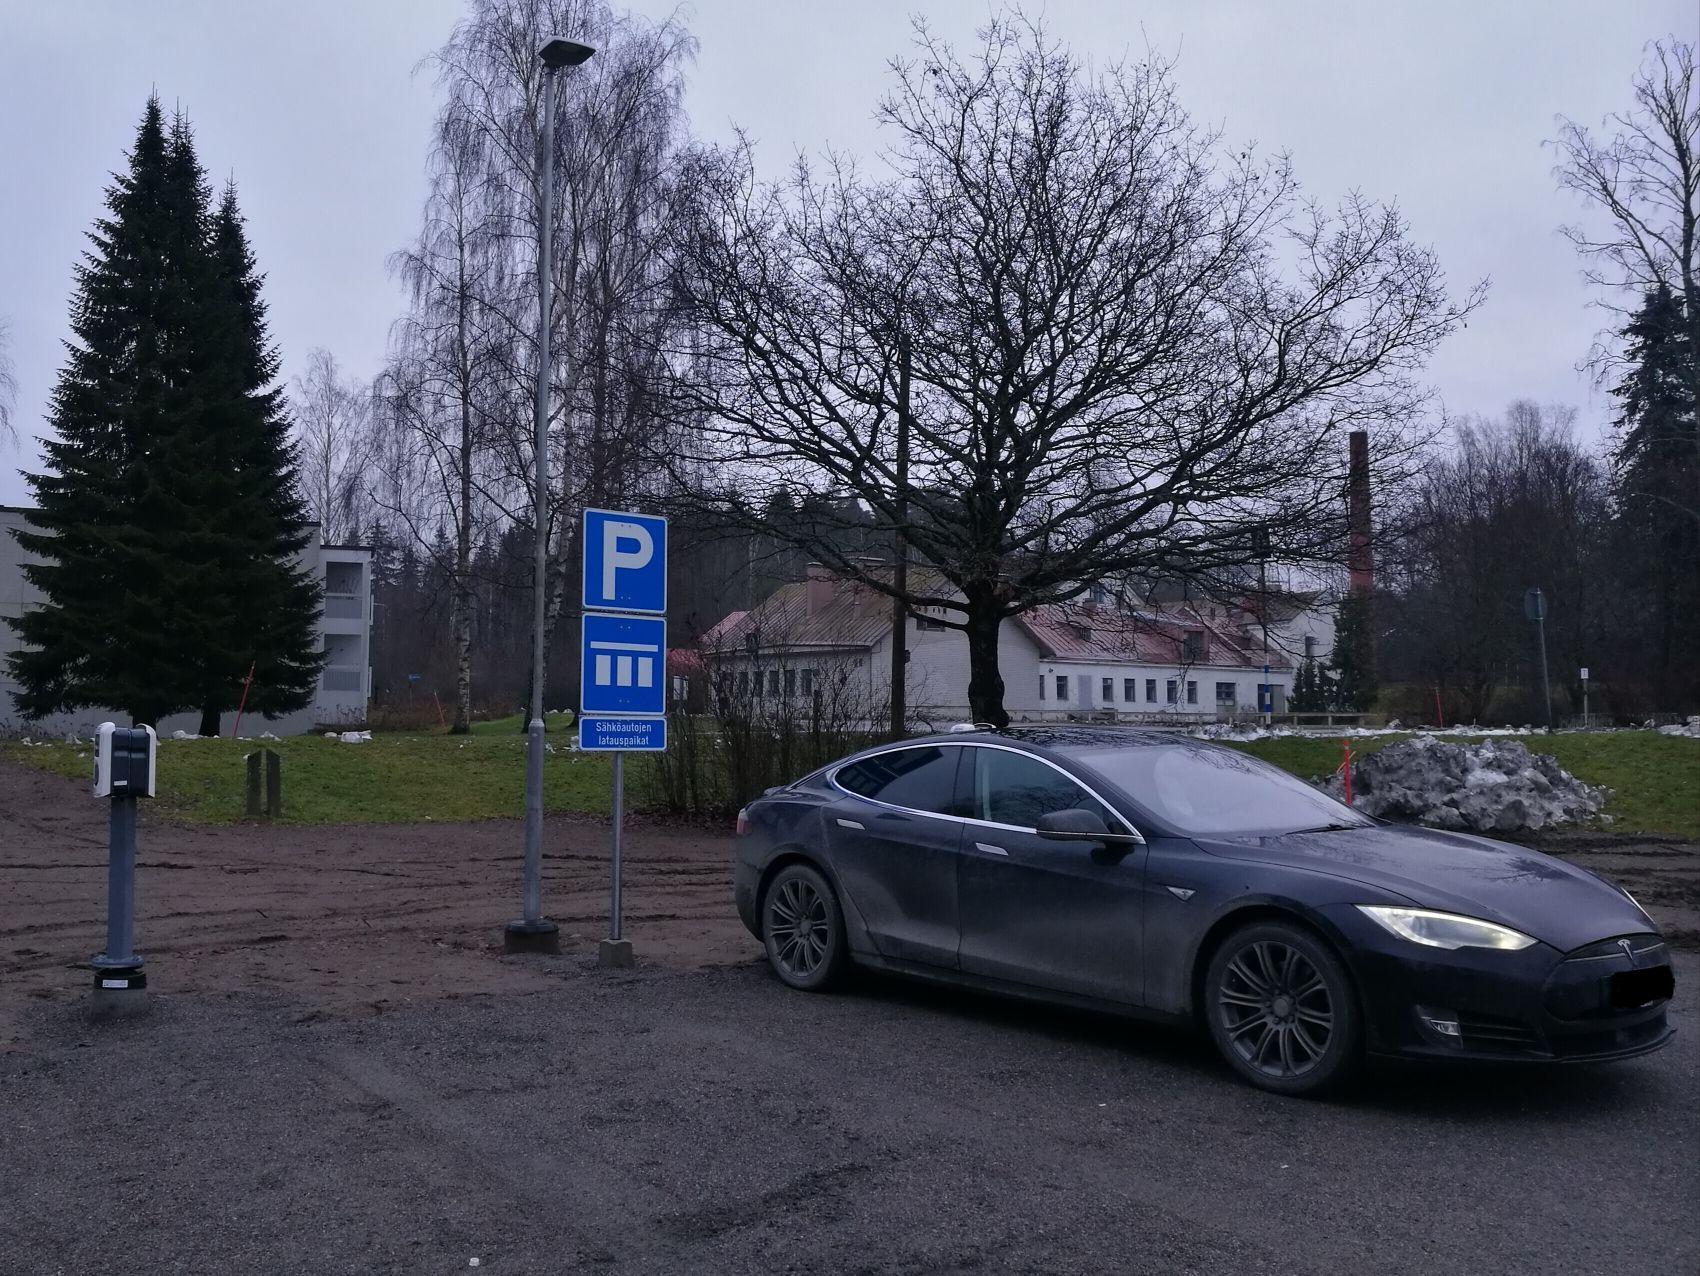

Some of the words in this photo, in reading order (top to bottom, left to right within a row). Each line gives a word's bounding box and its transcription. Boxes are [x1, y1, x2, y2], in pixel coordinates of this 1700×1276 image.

[603, 520, 654, 600] P
[596, 721, 652, 733] Sähköautojen
[599, 735, 649, 746] latauspaikat
